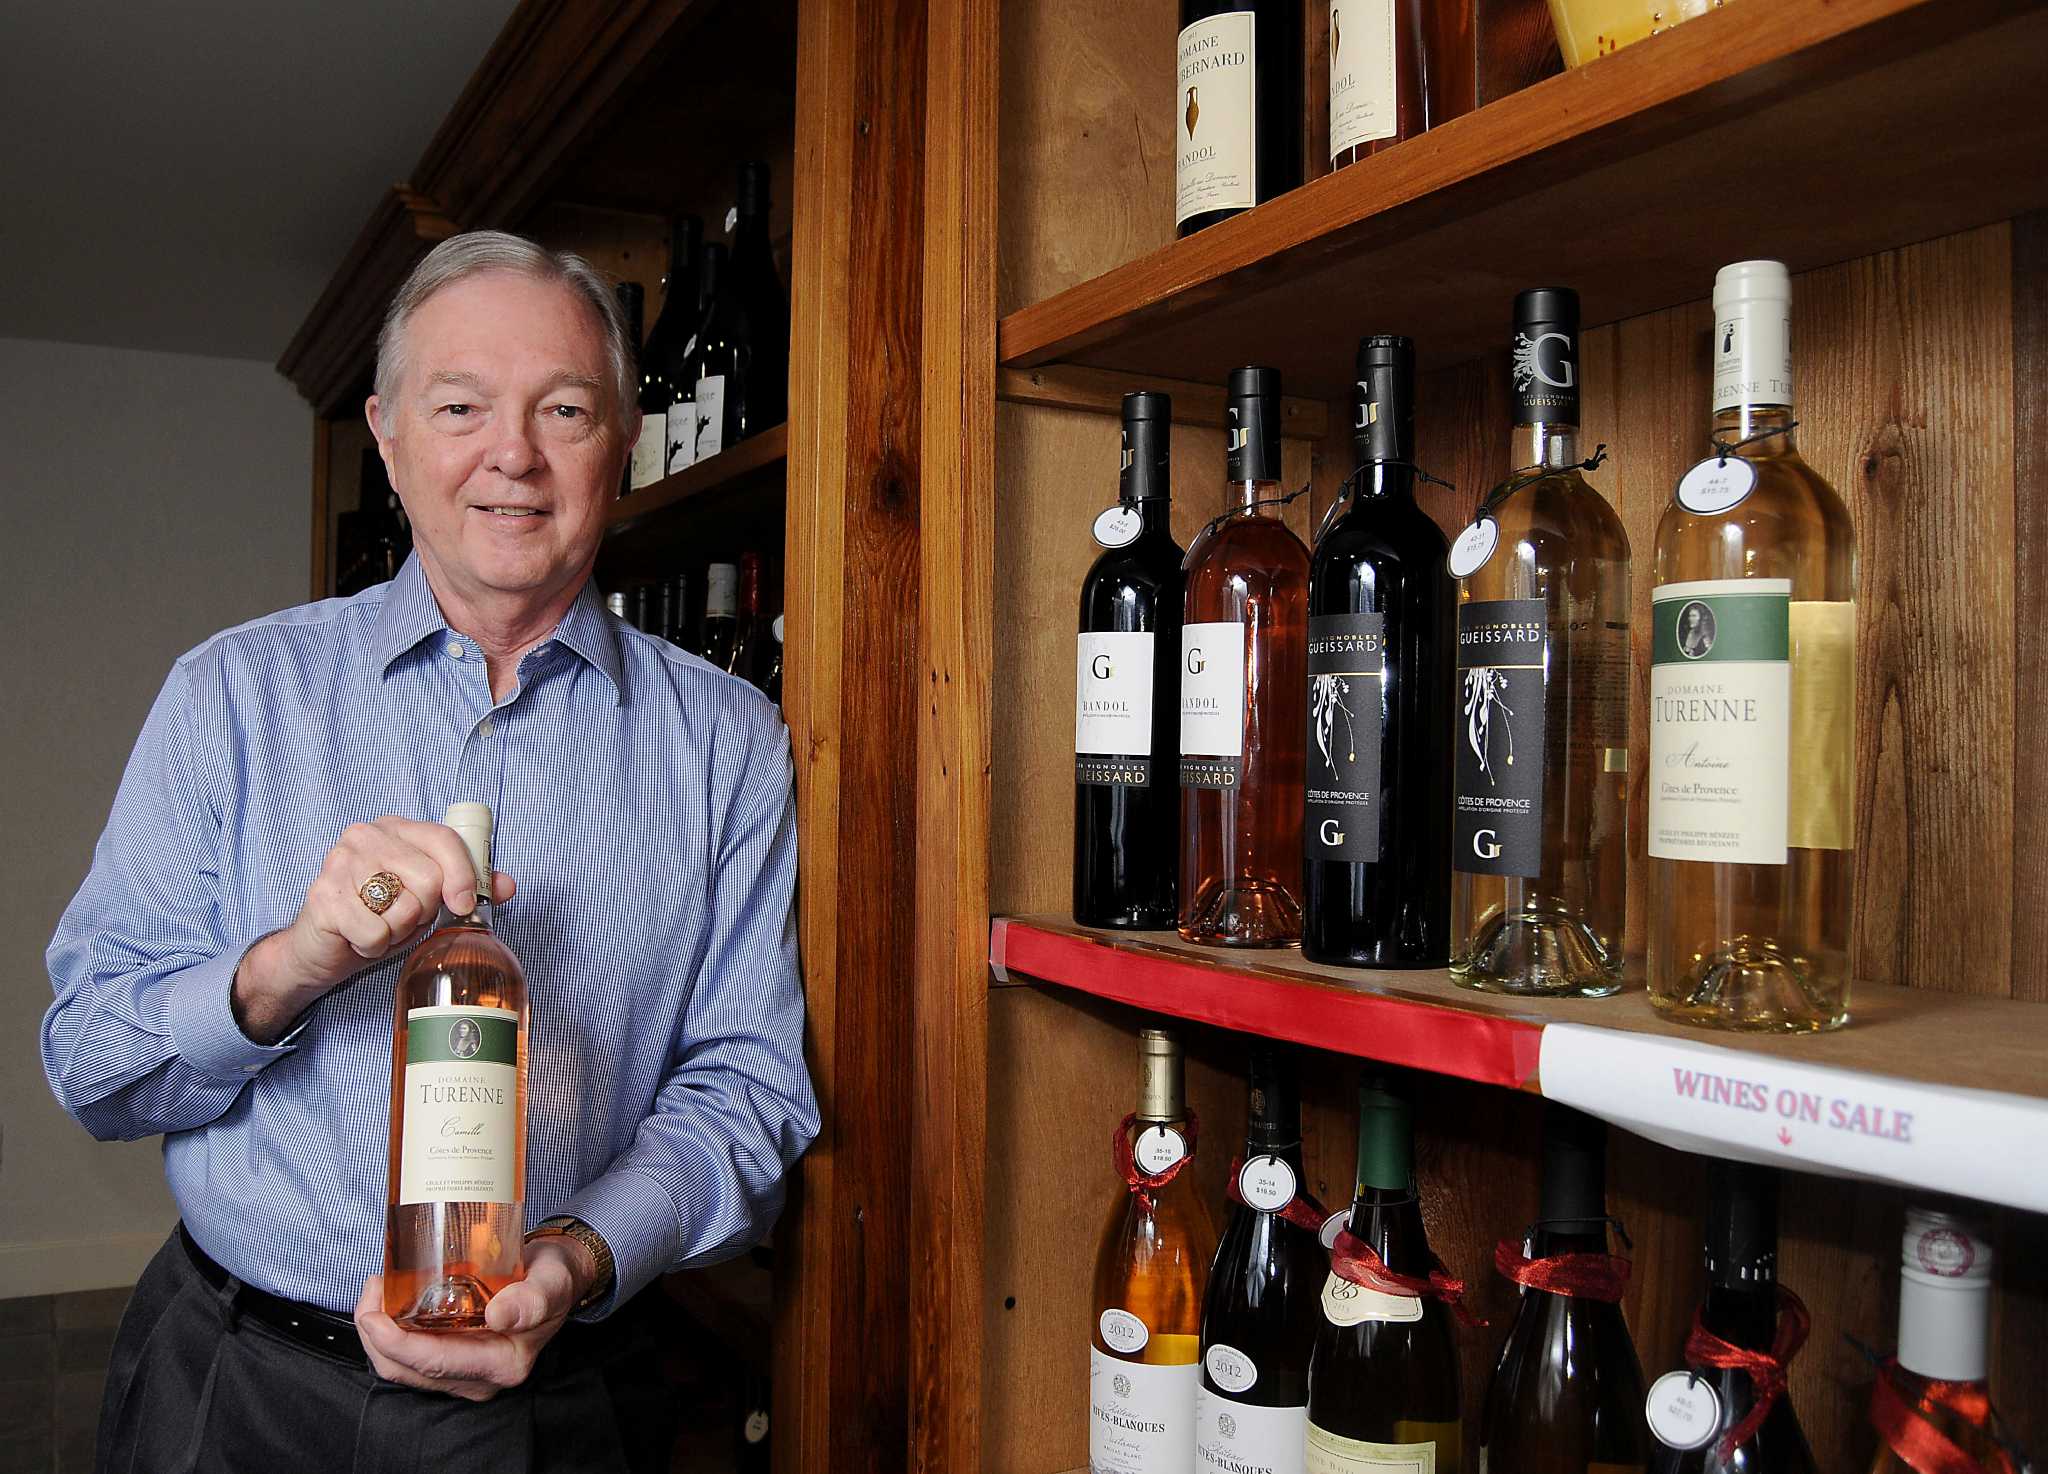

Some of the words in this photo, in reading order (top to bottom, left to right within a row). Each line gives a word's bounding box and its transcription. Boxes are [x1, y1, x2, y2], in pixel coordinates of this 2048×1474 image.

[1180, 35, 1219, 61] OMAINE
[1475, 622, 1540, 630] VIGNOBLES
[1460, 629, 1540, 645] GUEISSARD
[1308, 640, 1377, 655] GUEISSARD
[1665, 684, 1727, 696] DOMAINE
[1655, 696, 1758, 722] TURENNE
[1087, 763, 1146, 771] VIGNOBLES
[1183, 764, 1236, 773] VIGNOBLES
[1083, 769, 1146, 784] EISSARD
[1330, 791, 1370, 801] PROVENCE
[1475, 797, 1485, 807] DE
[1485, 798, 1531, 809] PROVENCE
[438, 1074, 487, 1084] DOMAINE
[420, 1084, 504, 1105] TURENNE
[1673, 1067, 1769, 1113] WINES
[1776, 1088, 1822, 1125] ON
[1829, 1099, 1914, 1144] SALE
[462, 1144, 493, 1155] Provence
[1107, 1322, 1136, 1340] 2012
[1215, 1359, 1242, 1378] 2012
[1093, 1402, 1166, 1433] IVES-BLANQUES
[1199, 1441, 1273, 1474] VES-BLANQUES
